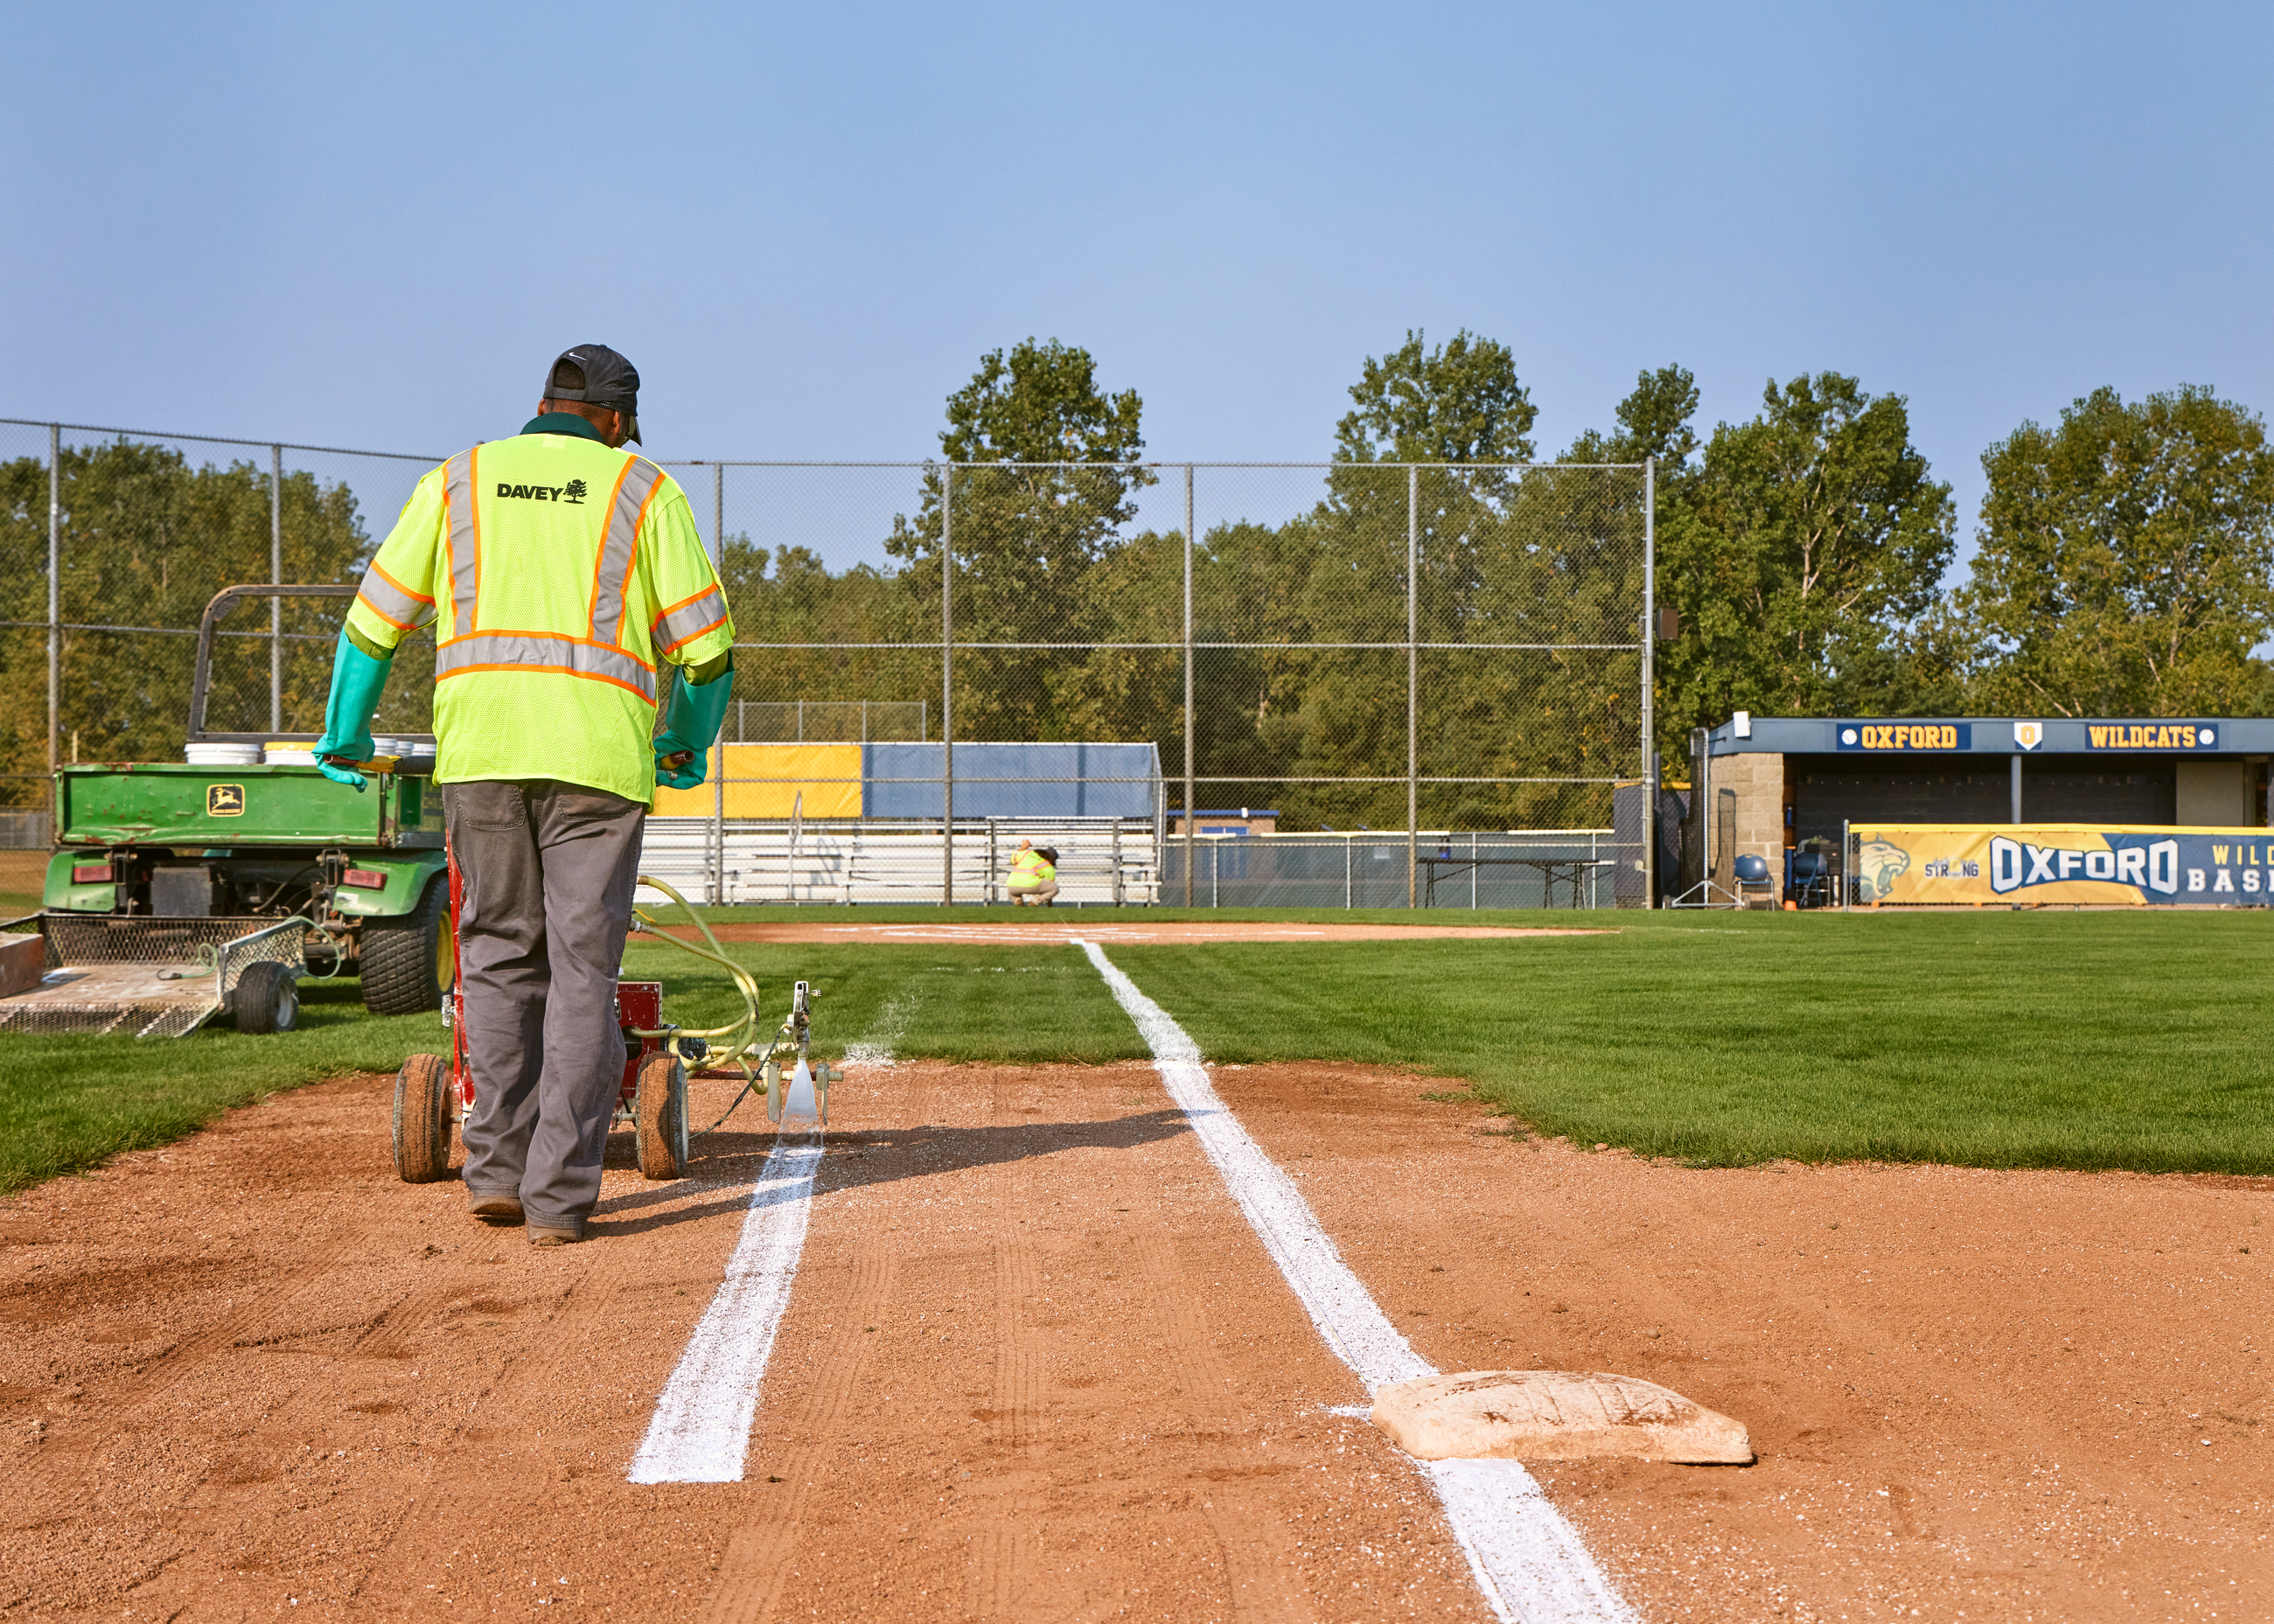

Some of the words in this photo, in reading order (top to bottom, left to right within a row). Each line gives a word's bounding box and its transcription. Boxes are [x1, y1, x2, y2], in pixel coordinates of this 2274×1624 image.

[497, 484, 564, 502] DAVEY
[1861, 725, 1957, 749] OXFORD
[2089, 725, 2196, 749] WILDCATS
[1991, 836, 2179, 895] OXFORD
